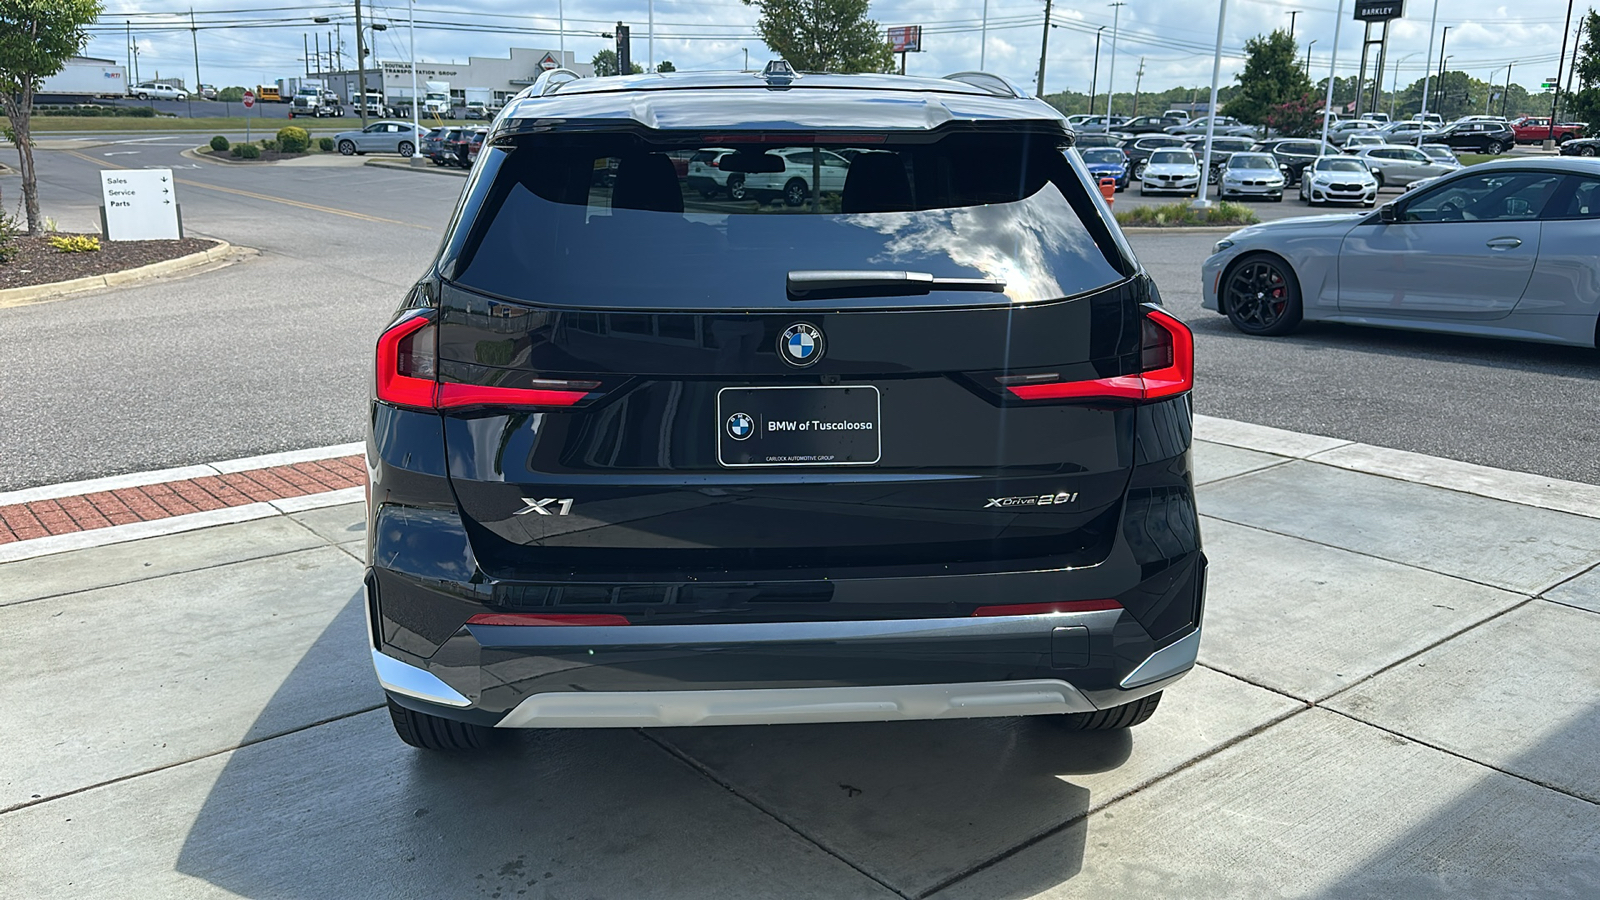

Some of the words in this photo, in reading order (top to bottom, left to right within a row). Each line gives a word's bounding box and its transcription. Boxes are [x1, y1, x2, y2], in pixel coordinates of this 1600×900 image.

[1361, 7, 1393, 16] BARKLEY
[107, 177, 128, 185] Sales
[784, 325, 819, 339] BMW
[768, 421, 797, 431] BMW
[799, 421, 810, 431] of
[812, 420, 873, 431] Tuscaloosa
[512, 497, 574, 516] X1
